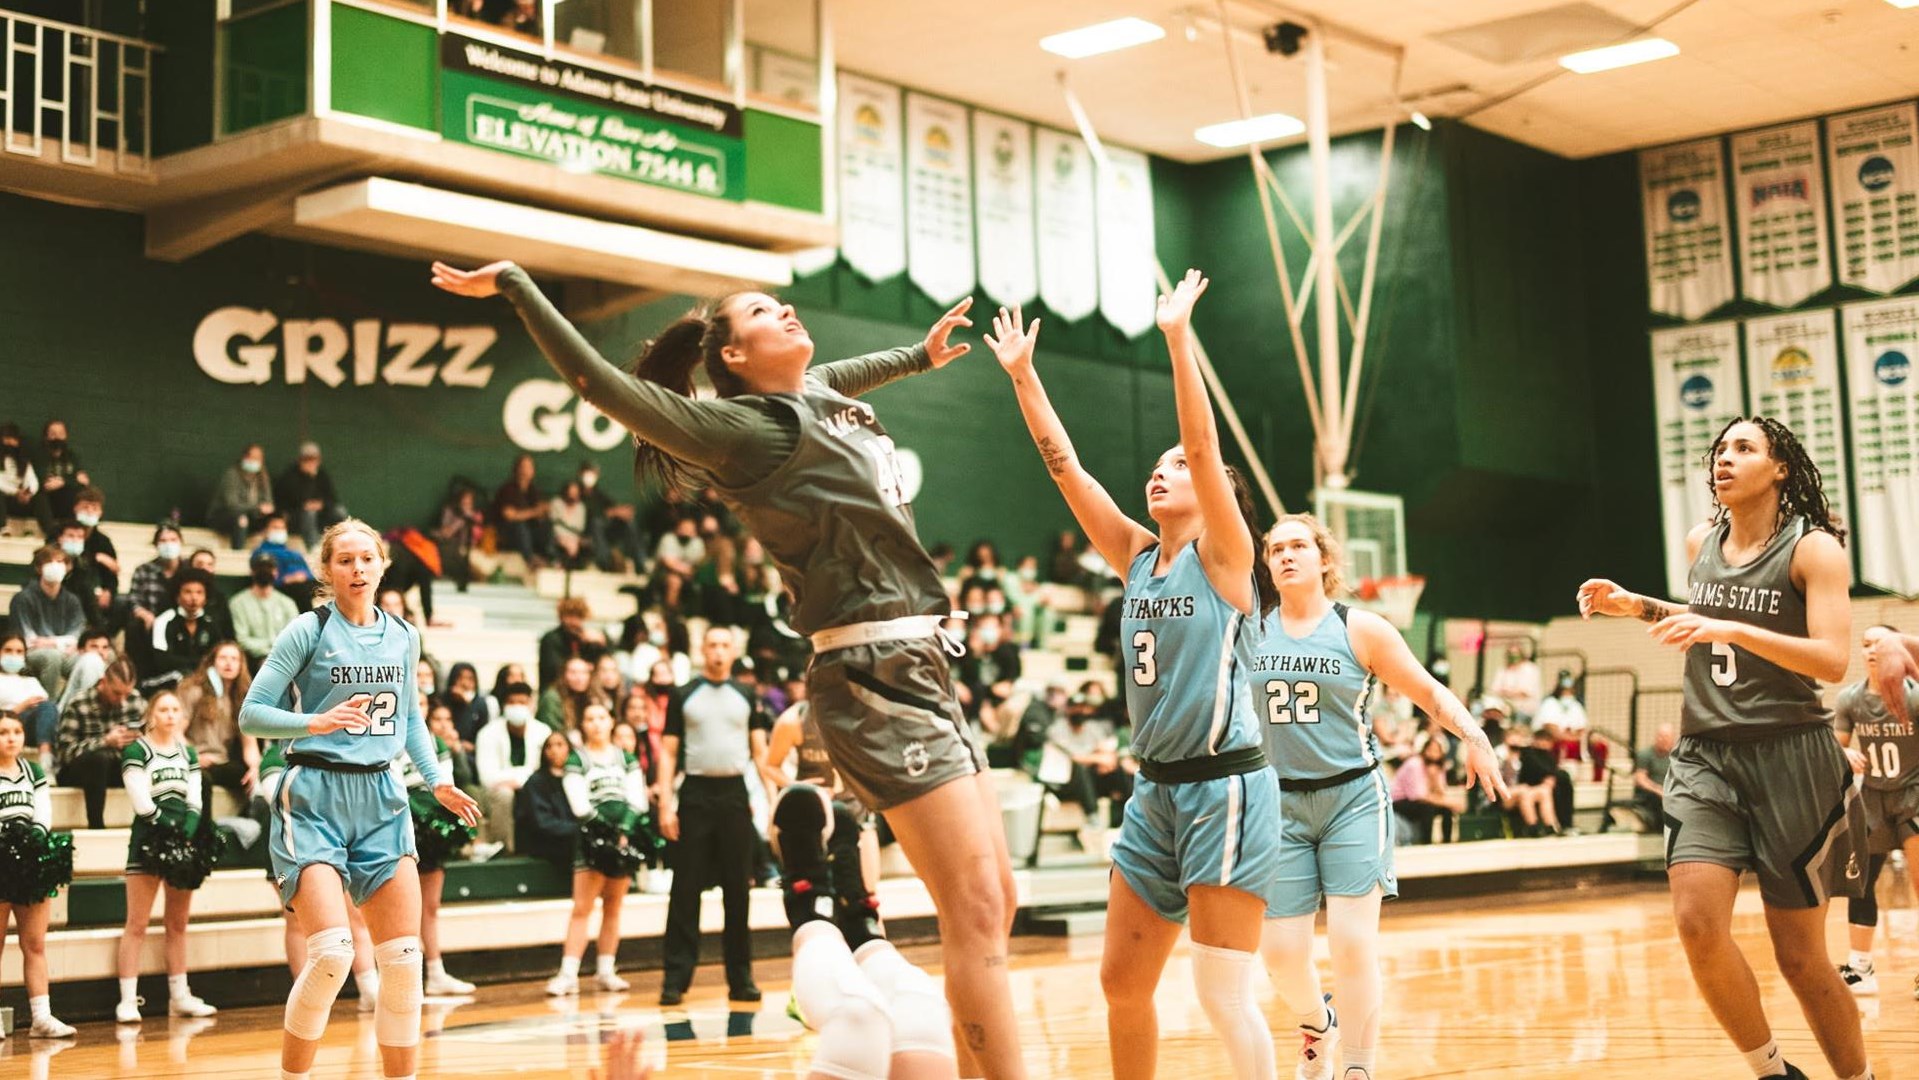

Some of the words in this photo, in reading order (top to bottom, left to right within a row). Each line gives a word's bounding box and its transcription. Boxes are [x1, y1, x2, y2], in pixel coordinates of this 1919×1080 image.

[465, 43, 538, 81] Welcome
[540, 65, 560, 86] to
[560, 67, 611, 99] Adams
[612, 80, 651, 109] State
[651, 89, 727, 131] University
[476, 113, 632, 174] ELEVATION
[635, 150, 694, 187] 7544
[193, 306, 498, 388] GRIZZ
[1121, 596, 1194, 619] YHAWKS
[1727, 585, 1782, 615] STATE
[1133, 630, 1158, 687] 3
[1265, 679, 1321, 725] 22
[1867, 741, 1900, 778] 10
